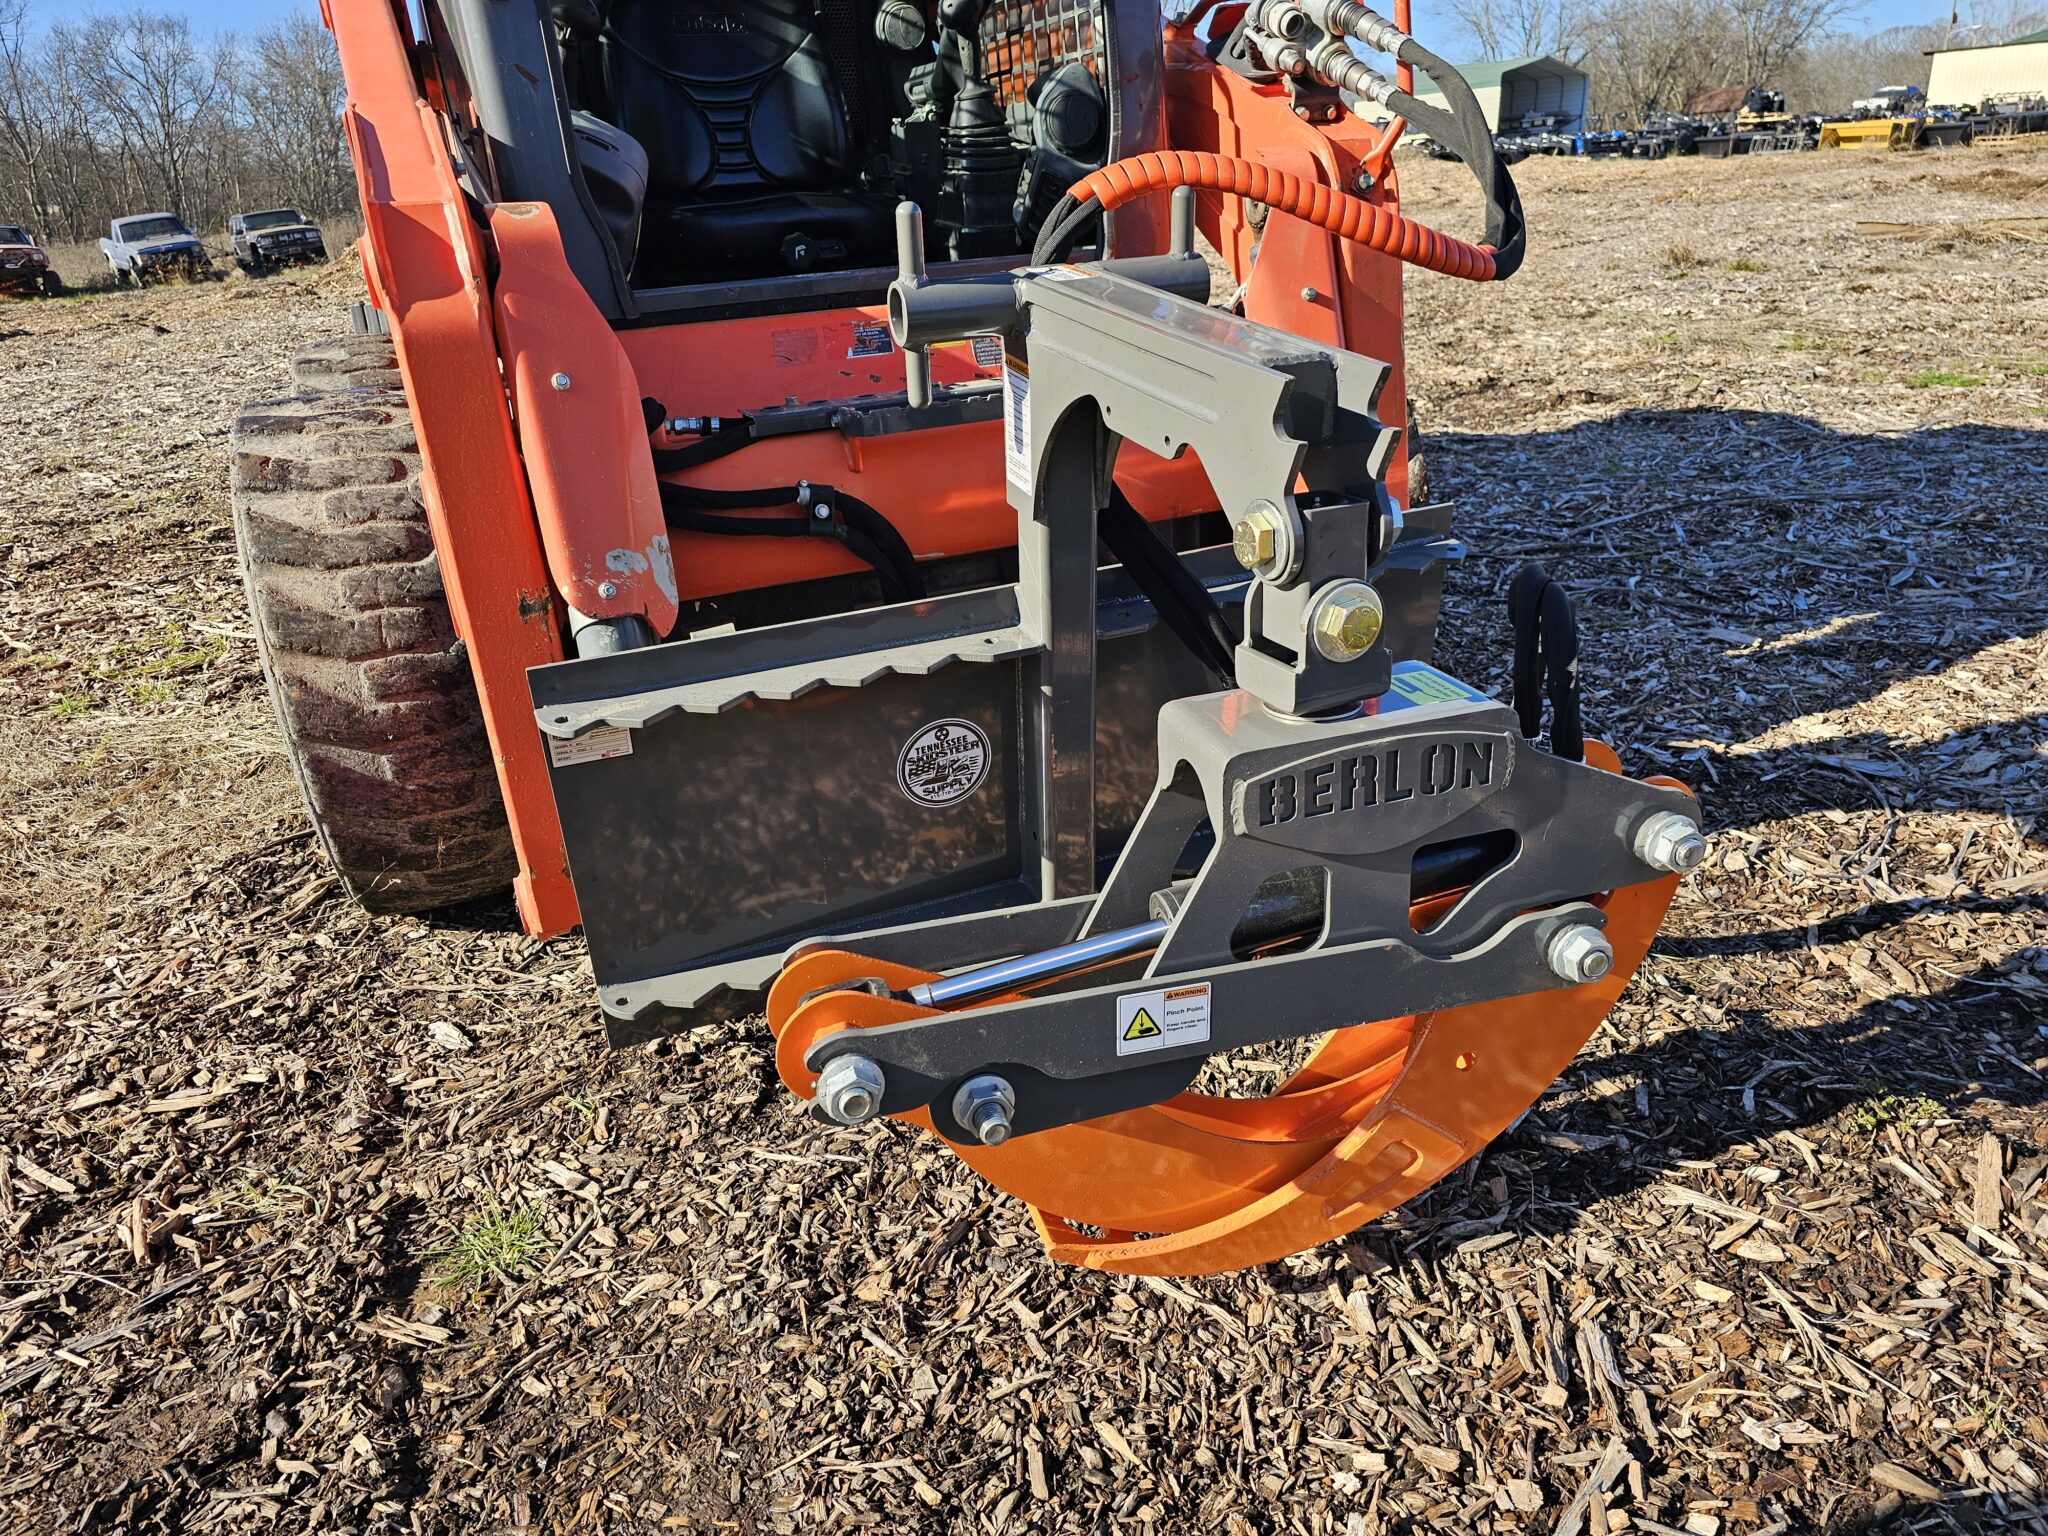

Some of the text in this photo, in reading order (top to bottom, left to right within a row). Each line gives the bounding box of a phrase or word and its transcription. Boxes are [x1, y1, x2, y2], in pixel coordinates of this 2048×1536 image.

[907, 740, 980, 764] SKIDSTEER
[915, 735, 968, 755] TENNESSEE
[923, 774, 975, 796] SUPPLY
[1259, 742, 1495, 827] BERLON
[1173, 988, 1207, 998] WARNING
